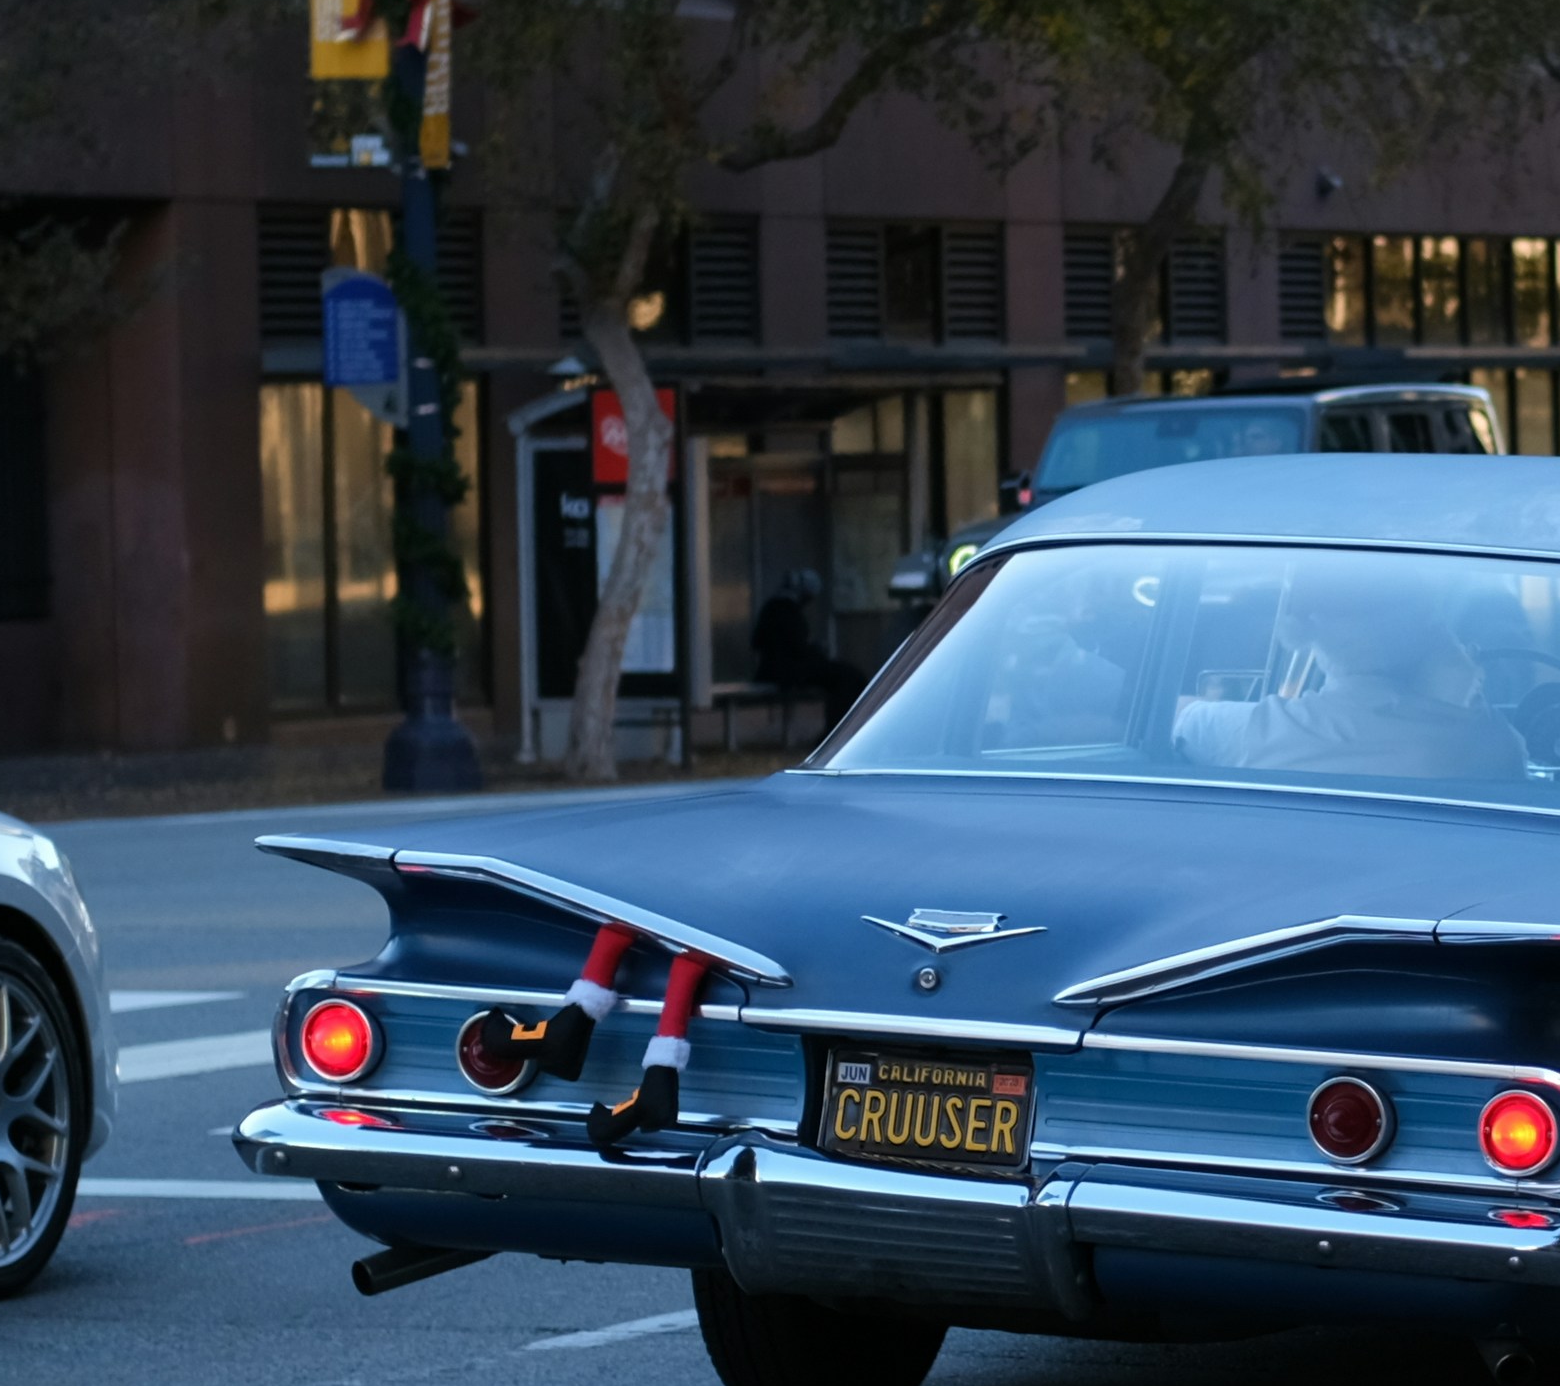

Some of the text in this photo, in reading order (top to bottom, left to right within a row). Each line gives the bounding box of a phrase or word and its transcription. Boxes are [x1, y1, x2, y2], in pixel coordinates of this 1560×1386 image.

[841, 1065, 868, 1081] JUN
[878, 1065, 987, 1088] CALIFORNIA
[834, 1089, 1019, 1154] CRUUSER
